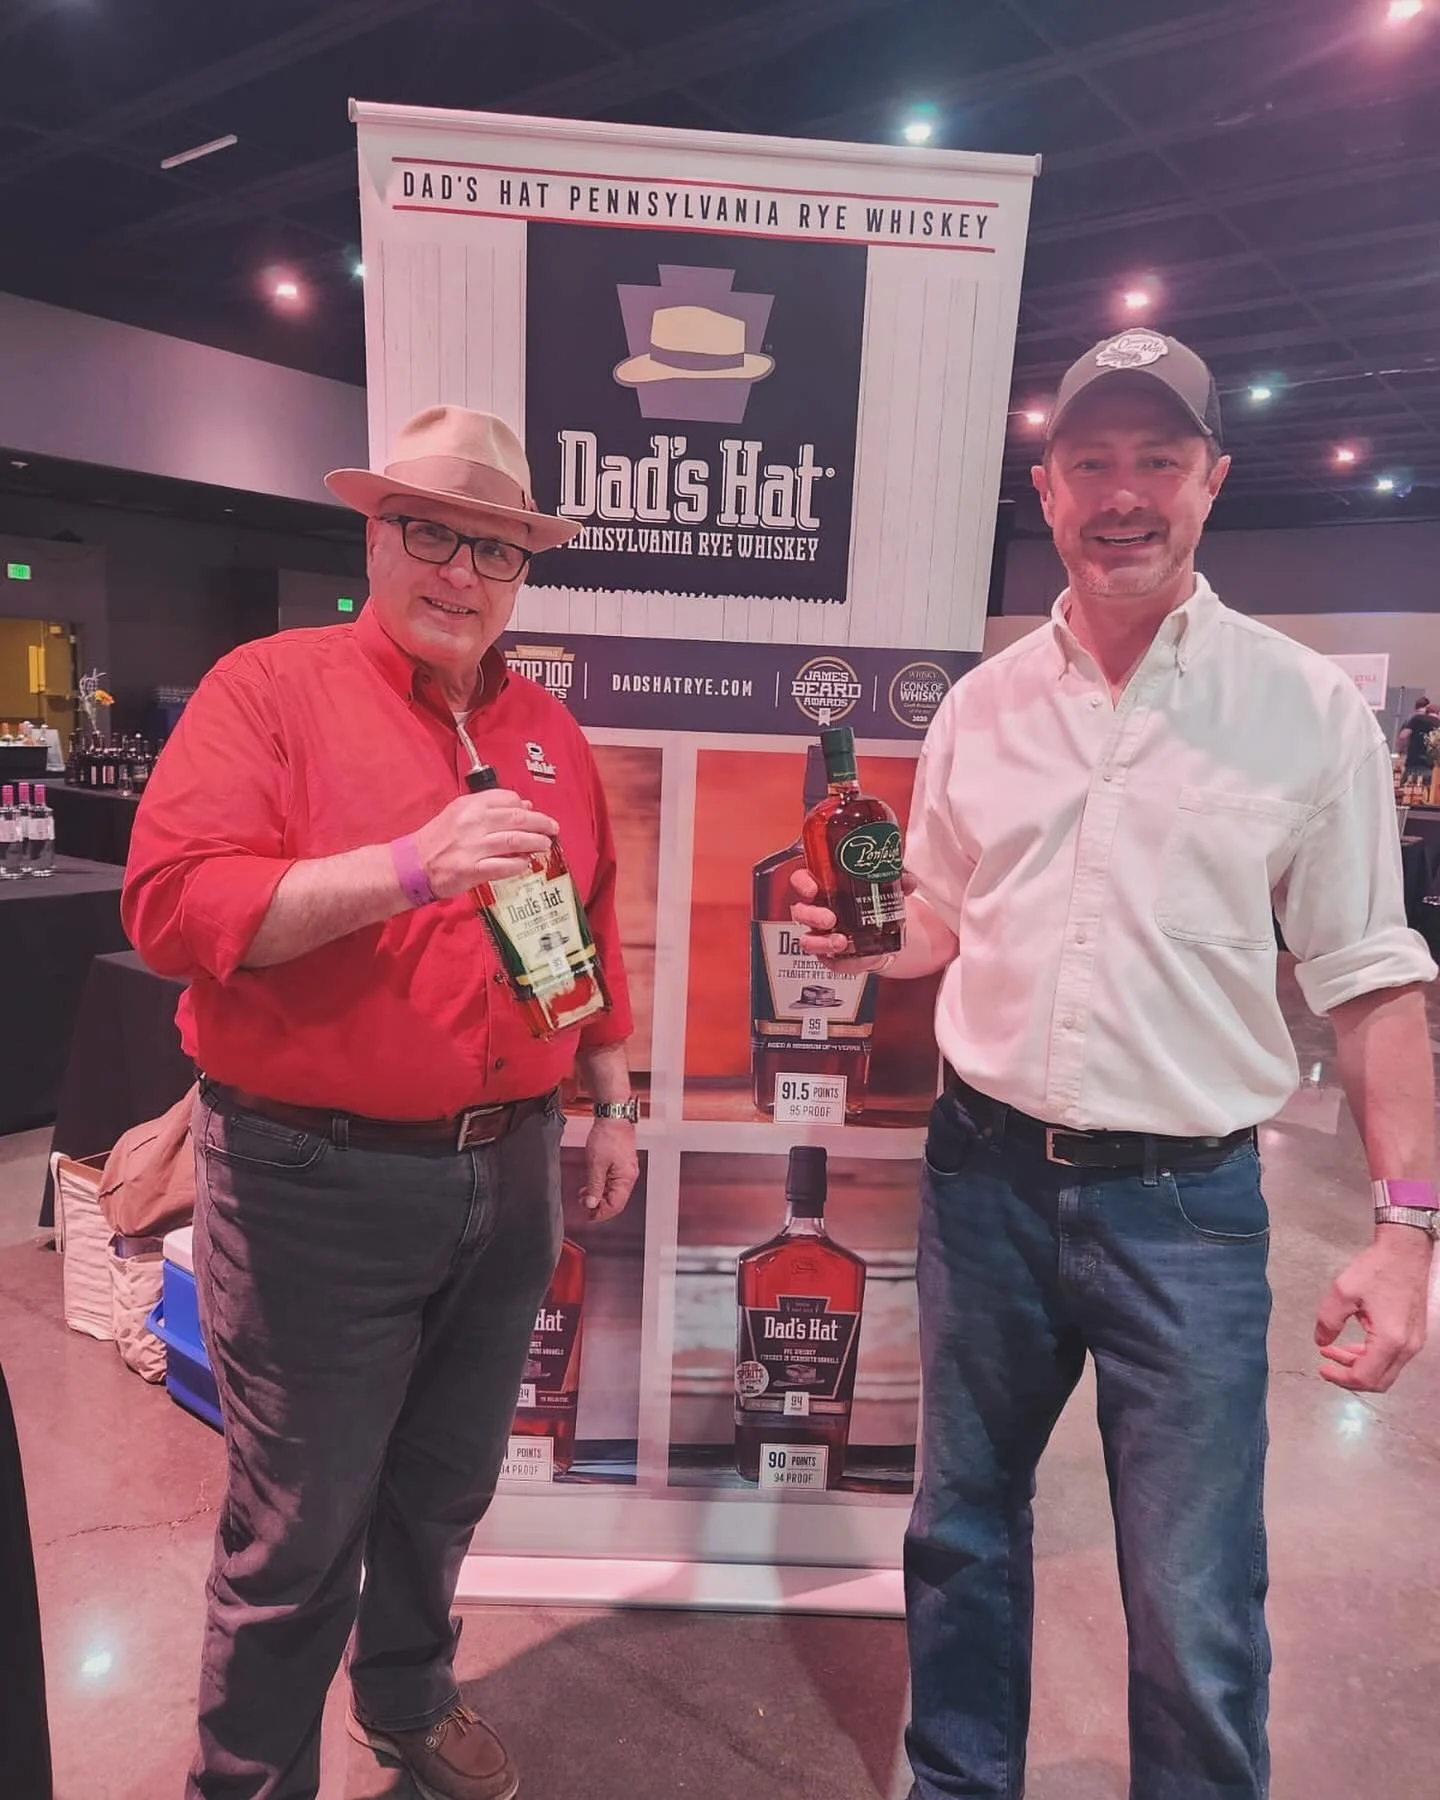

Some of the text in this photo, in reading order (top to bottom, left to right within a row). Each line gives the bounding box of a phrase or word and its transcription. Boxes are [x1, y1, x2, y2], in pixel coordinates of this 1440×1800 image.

[403, 171, 988, 239] DAD'S HAT PENNSYLVANIA RYE WHISKEY
[557, 430, 824, 532] Dad's Hat
[557, 526, 819, 562] ENNSYLVANIA RYE WHISKEY
[544, 661, 573, 688] 100
[804, 671, 849, 682] JAMES
[612, 674, 753, 697] DADSHATRYE.COM
[791, 681, 862, 698] BEARD
[900, 681, 944, 693] ICONS OF
[803, 697, 848, 707] AWARDS
[901, 690, 943, 702] WHISKY
[507, 897, 541, 923] Dad's
[541, 887, 565, 909] Hat
[808, 1018, 821, 1030] 95
[782, 1081, 839, 1100] 91.5 POINTS
[790, 1105, 831, 1117] 95 PROOF
[533, 1308, 565, 1332] Hat
[764, 1316, 839, 1341] Dad's Hat
[516, 1447, 542, 1458] POINTS
[769, 1451, 817, 1468] 90 POINTS
[512, 1465, 538, 1475] PROOF
[774, 1472, 814, 1484] 94 PROOF
